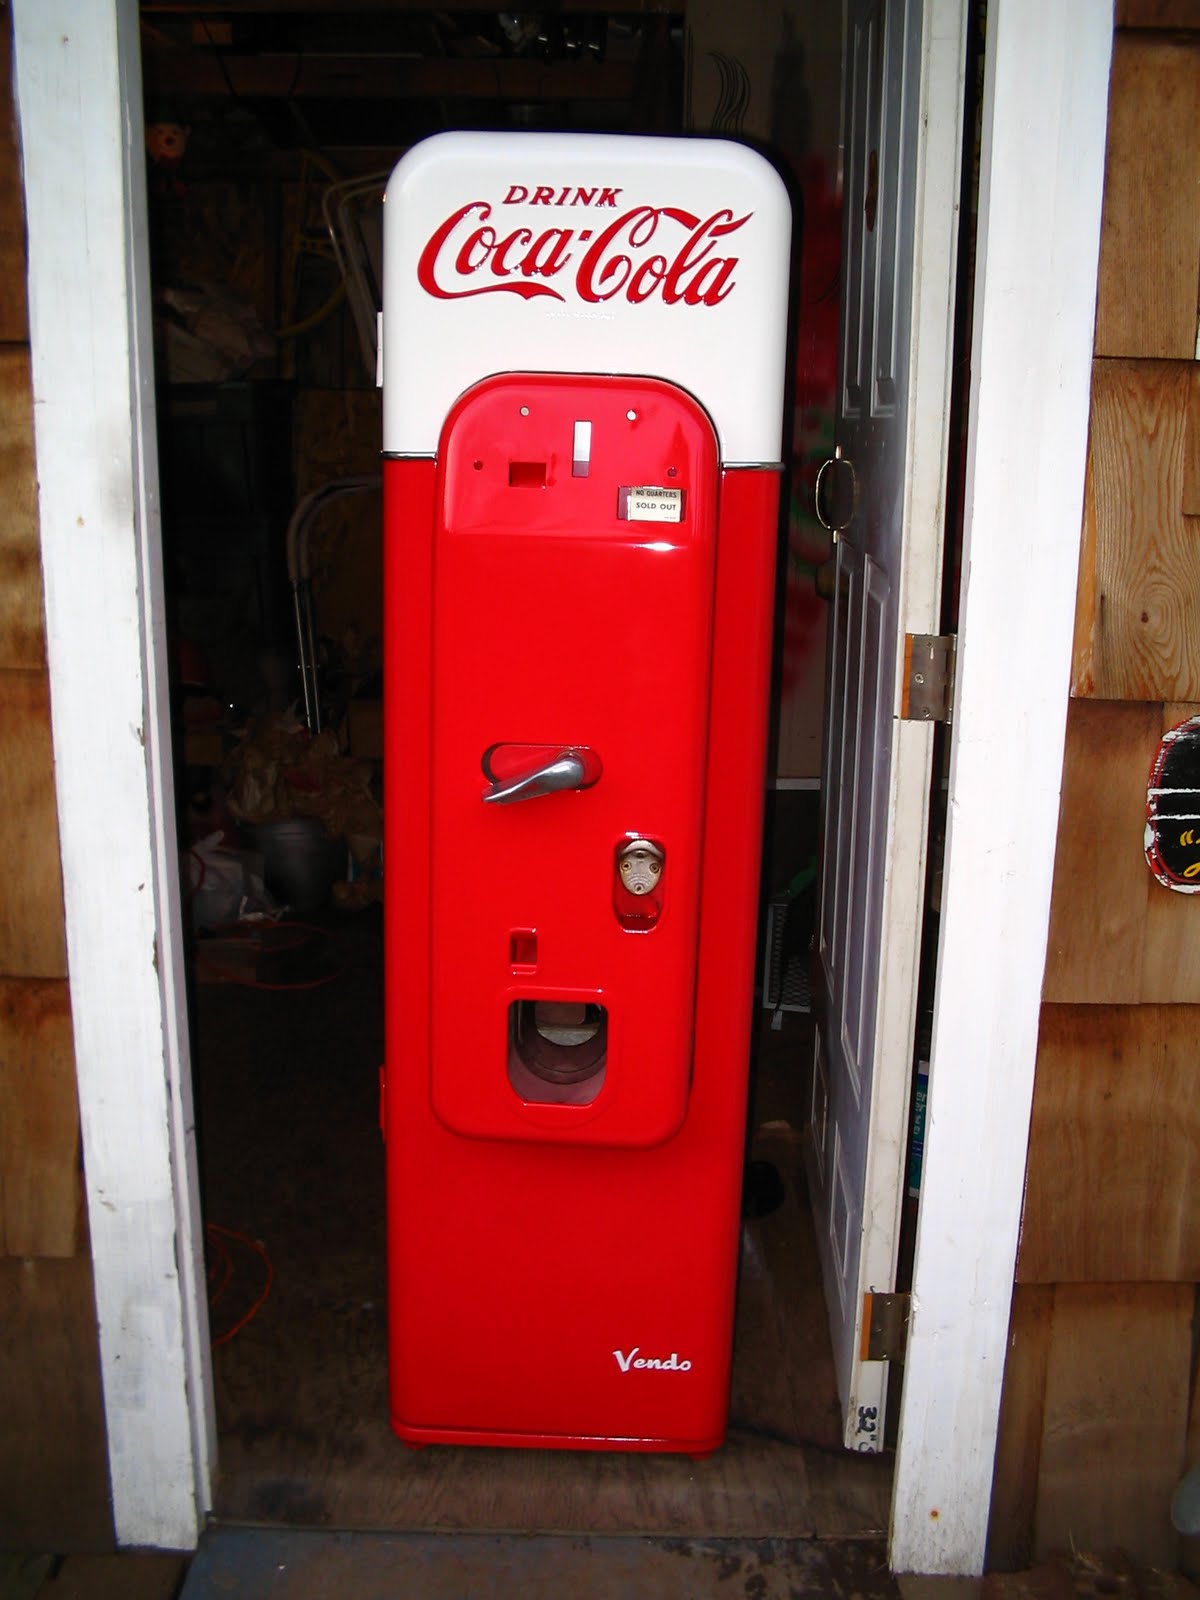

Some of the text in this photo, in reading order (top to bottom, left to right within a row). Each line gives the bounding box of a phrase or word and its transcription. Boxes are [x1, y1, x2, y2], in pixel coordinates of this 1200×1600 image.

[502, 185, 623, 208] DRINK
[417, 201, 754, 306] Coca-Cola
[646, 490, 677, 498] QUARTERS
[612, 1347, 692, 1372] Vendo
